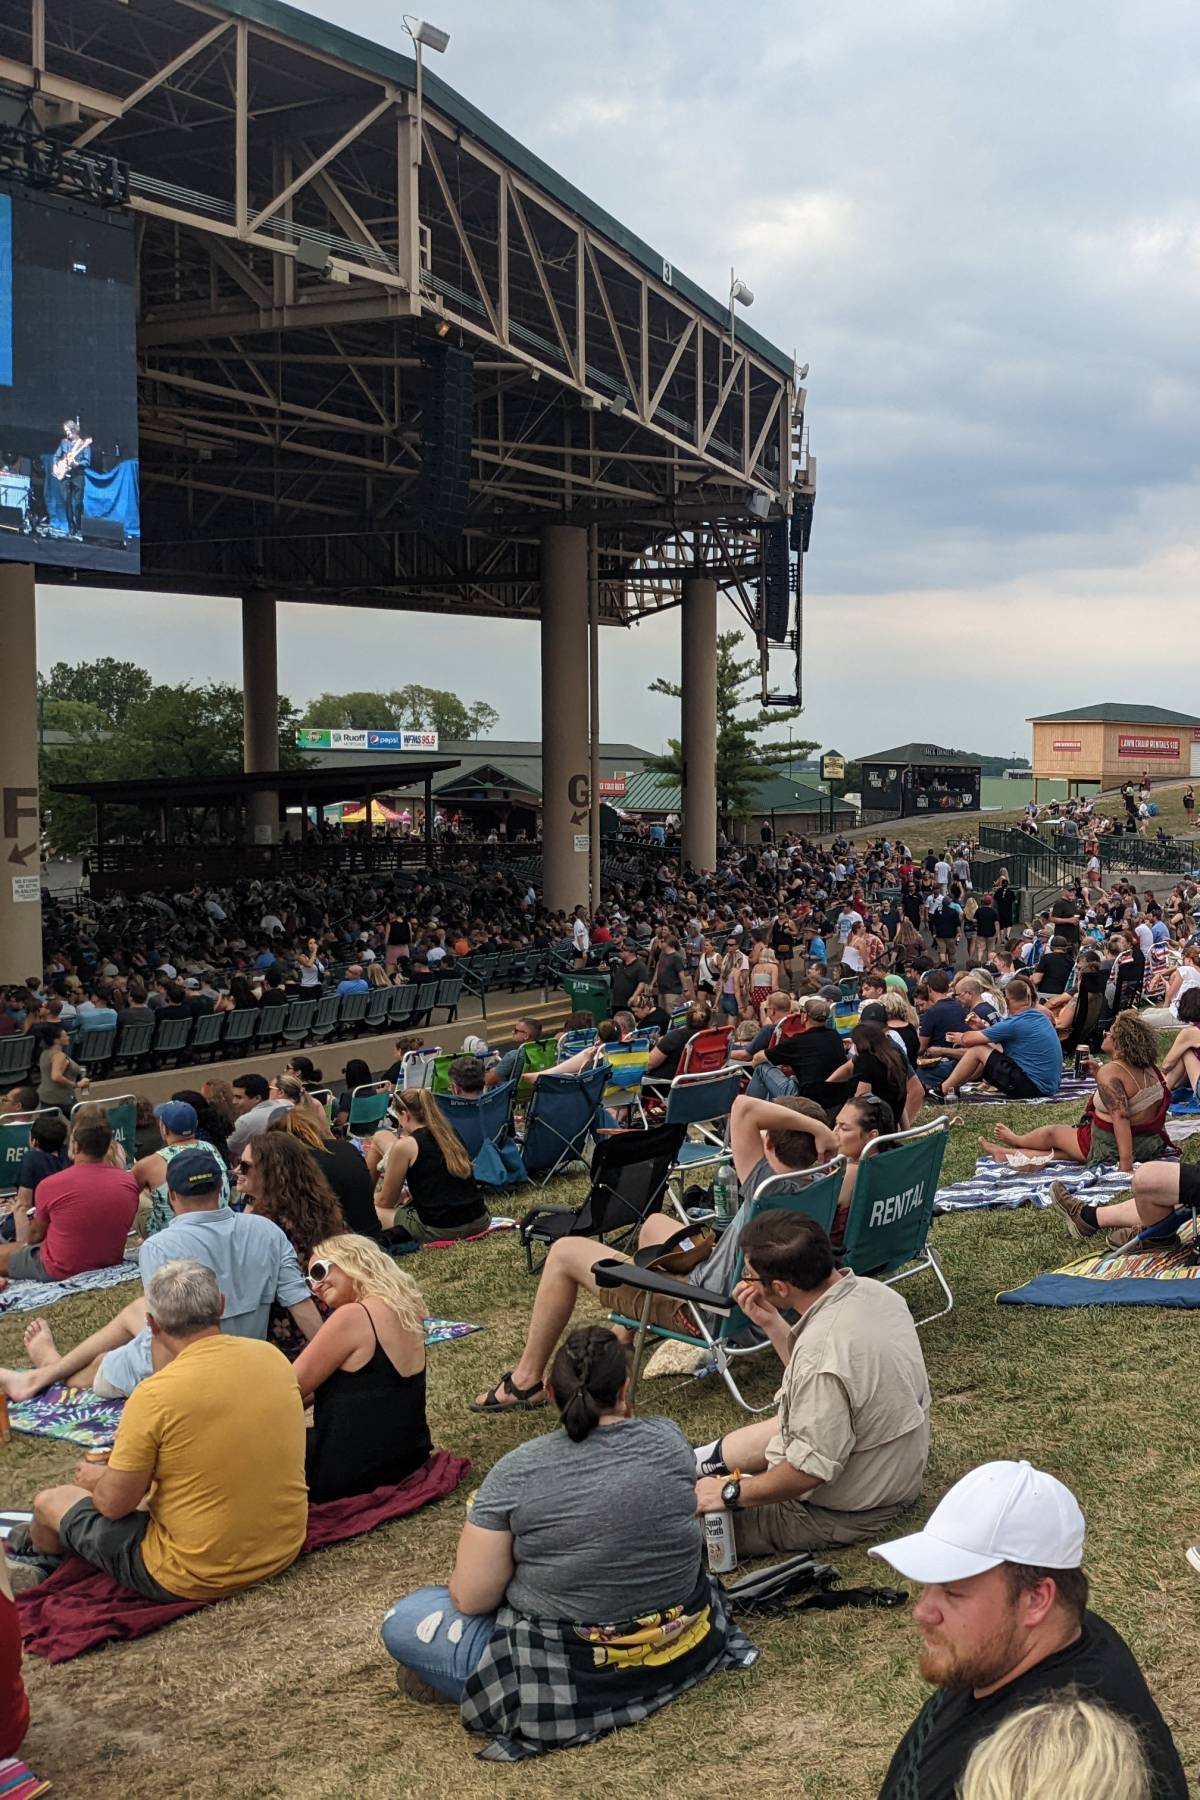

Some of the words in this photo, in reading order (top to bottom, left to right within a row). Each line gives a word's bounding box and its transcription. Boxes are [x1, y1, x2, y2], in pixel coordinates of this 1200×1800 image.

[343, 733, 366, 741] Ruoff
[380, 736, 399, 744] pepsi
[403, 735, 421, 744] WFMS
[421, 735, 436, 745] 95.5
[1120, 739, 1135, 747] LAWN
[1135, 740, 1149, 748] CHAIR
[1149, 740, 1169, 749] RENTALS
[568, 774, 590, 808] G
[3, 787, 38, 839] F
[869, 1180, 925, 1228] RENTAL
